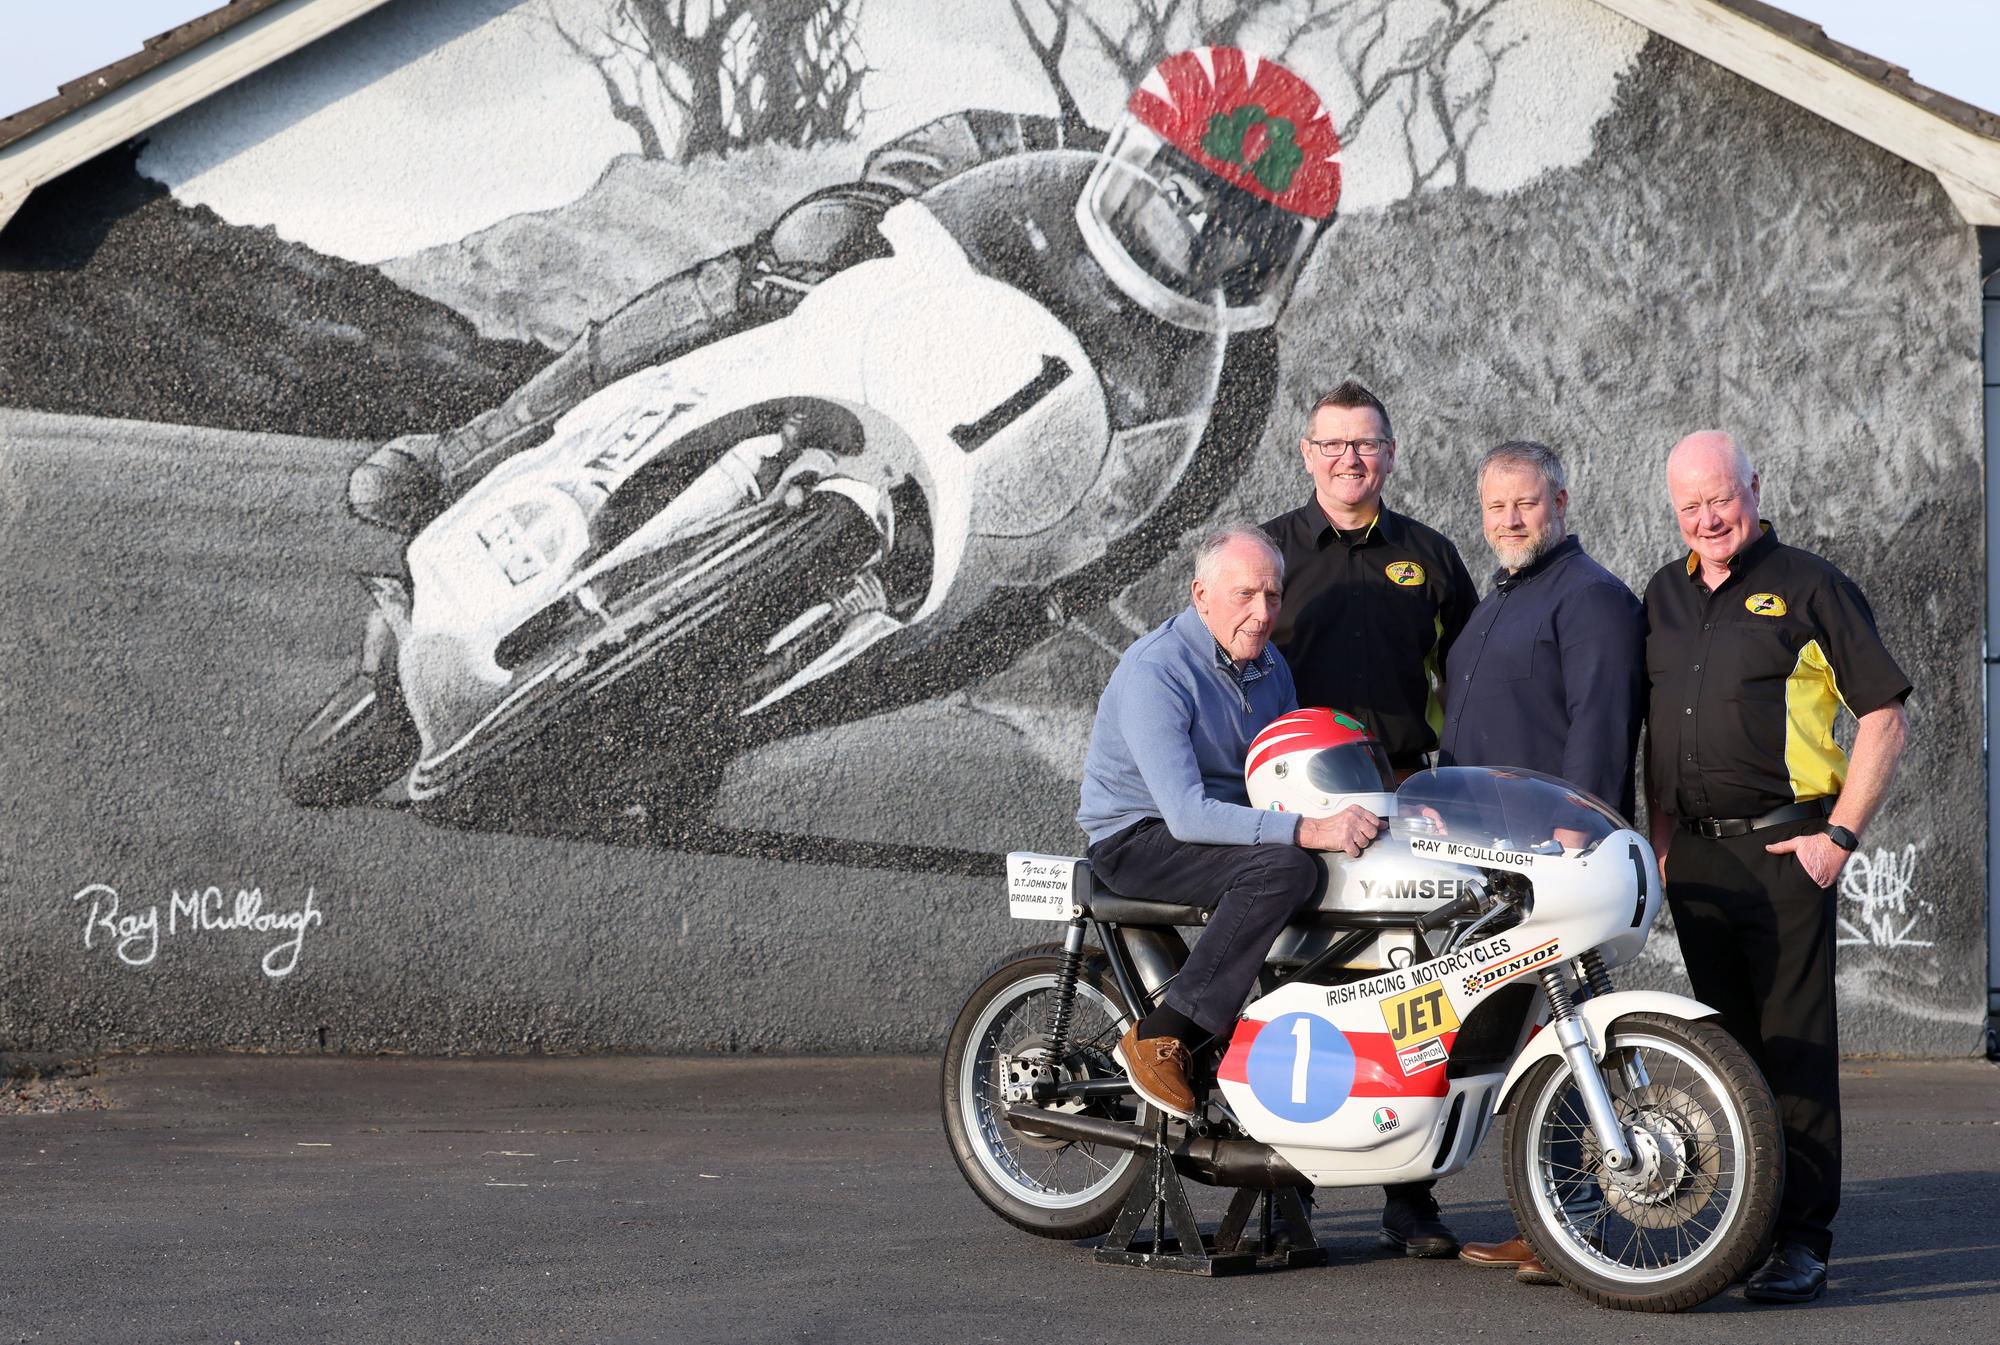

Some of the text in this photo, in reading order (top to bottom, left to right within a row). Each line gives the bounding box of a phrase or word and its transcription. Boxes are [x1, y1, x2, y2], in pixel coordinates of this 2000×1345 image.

[947, 353, 1073, 453] 1
[1021, 861, 1047, 877] Tyres
[1418, 840, 1534, 867] RAY McCULLOUGH
[1010, 893, 1064, 905] DROMARA 370
[1014, 878, 1068, 890] D.T.JOHNSTON
[1629, 844, 1648, 928] 1
[73, 883, 158, 965] Ray
[1326, 938, 1512, 1007] IRISH RACING MOTORCYCLES
[1482, 943, 1559, 984] DUNLOP
[1391, 988, 1444, 1041] JET
[1290, 1018, 1311, 1105] 1
[1403, 1046, 1442, 1067] CHAMPION
